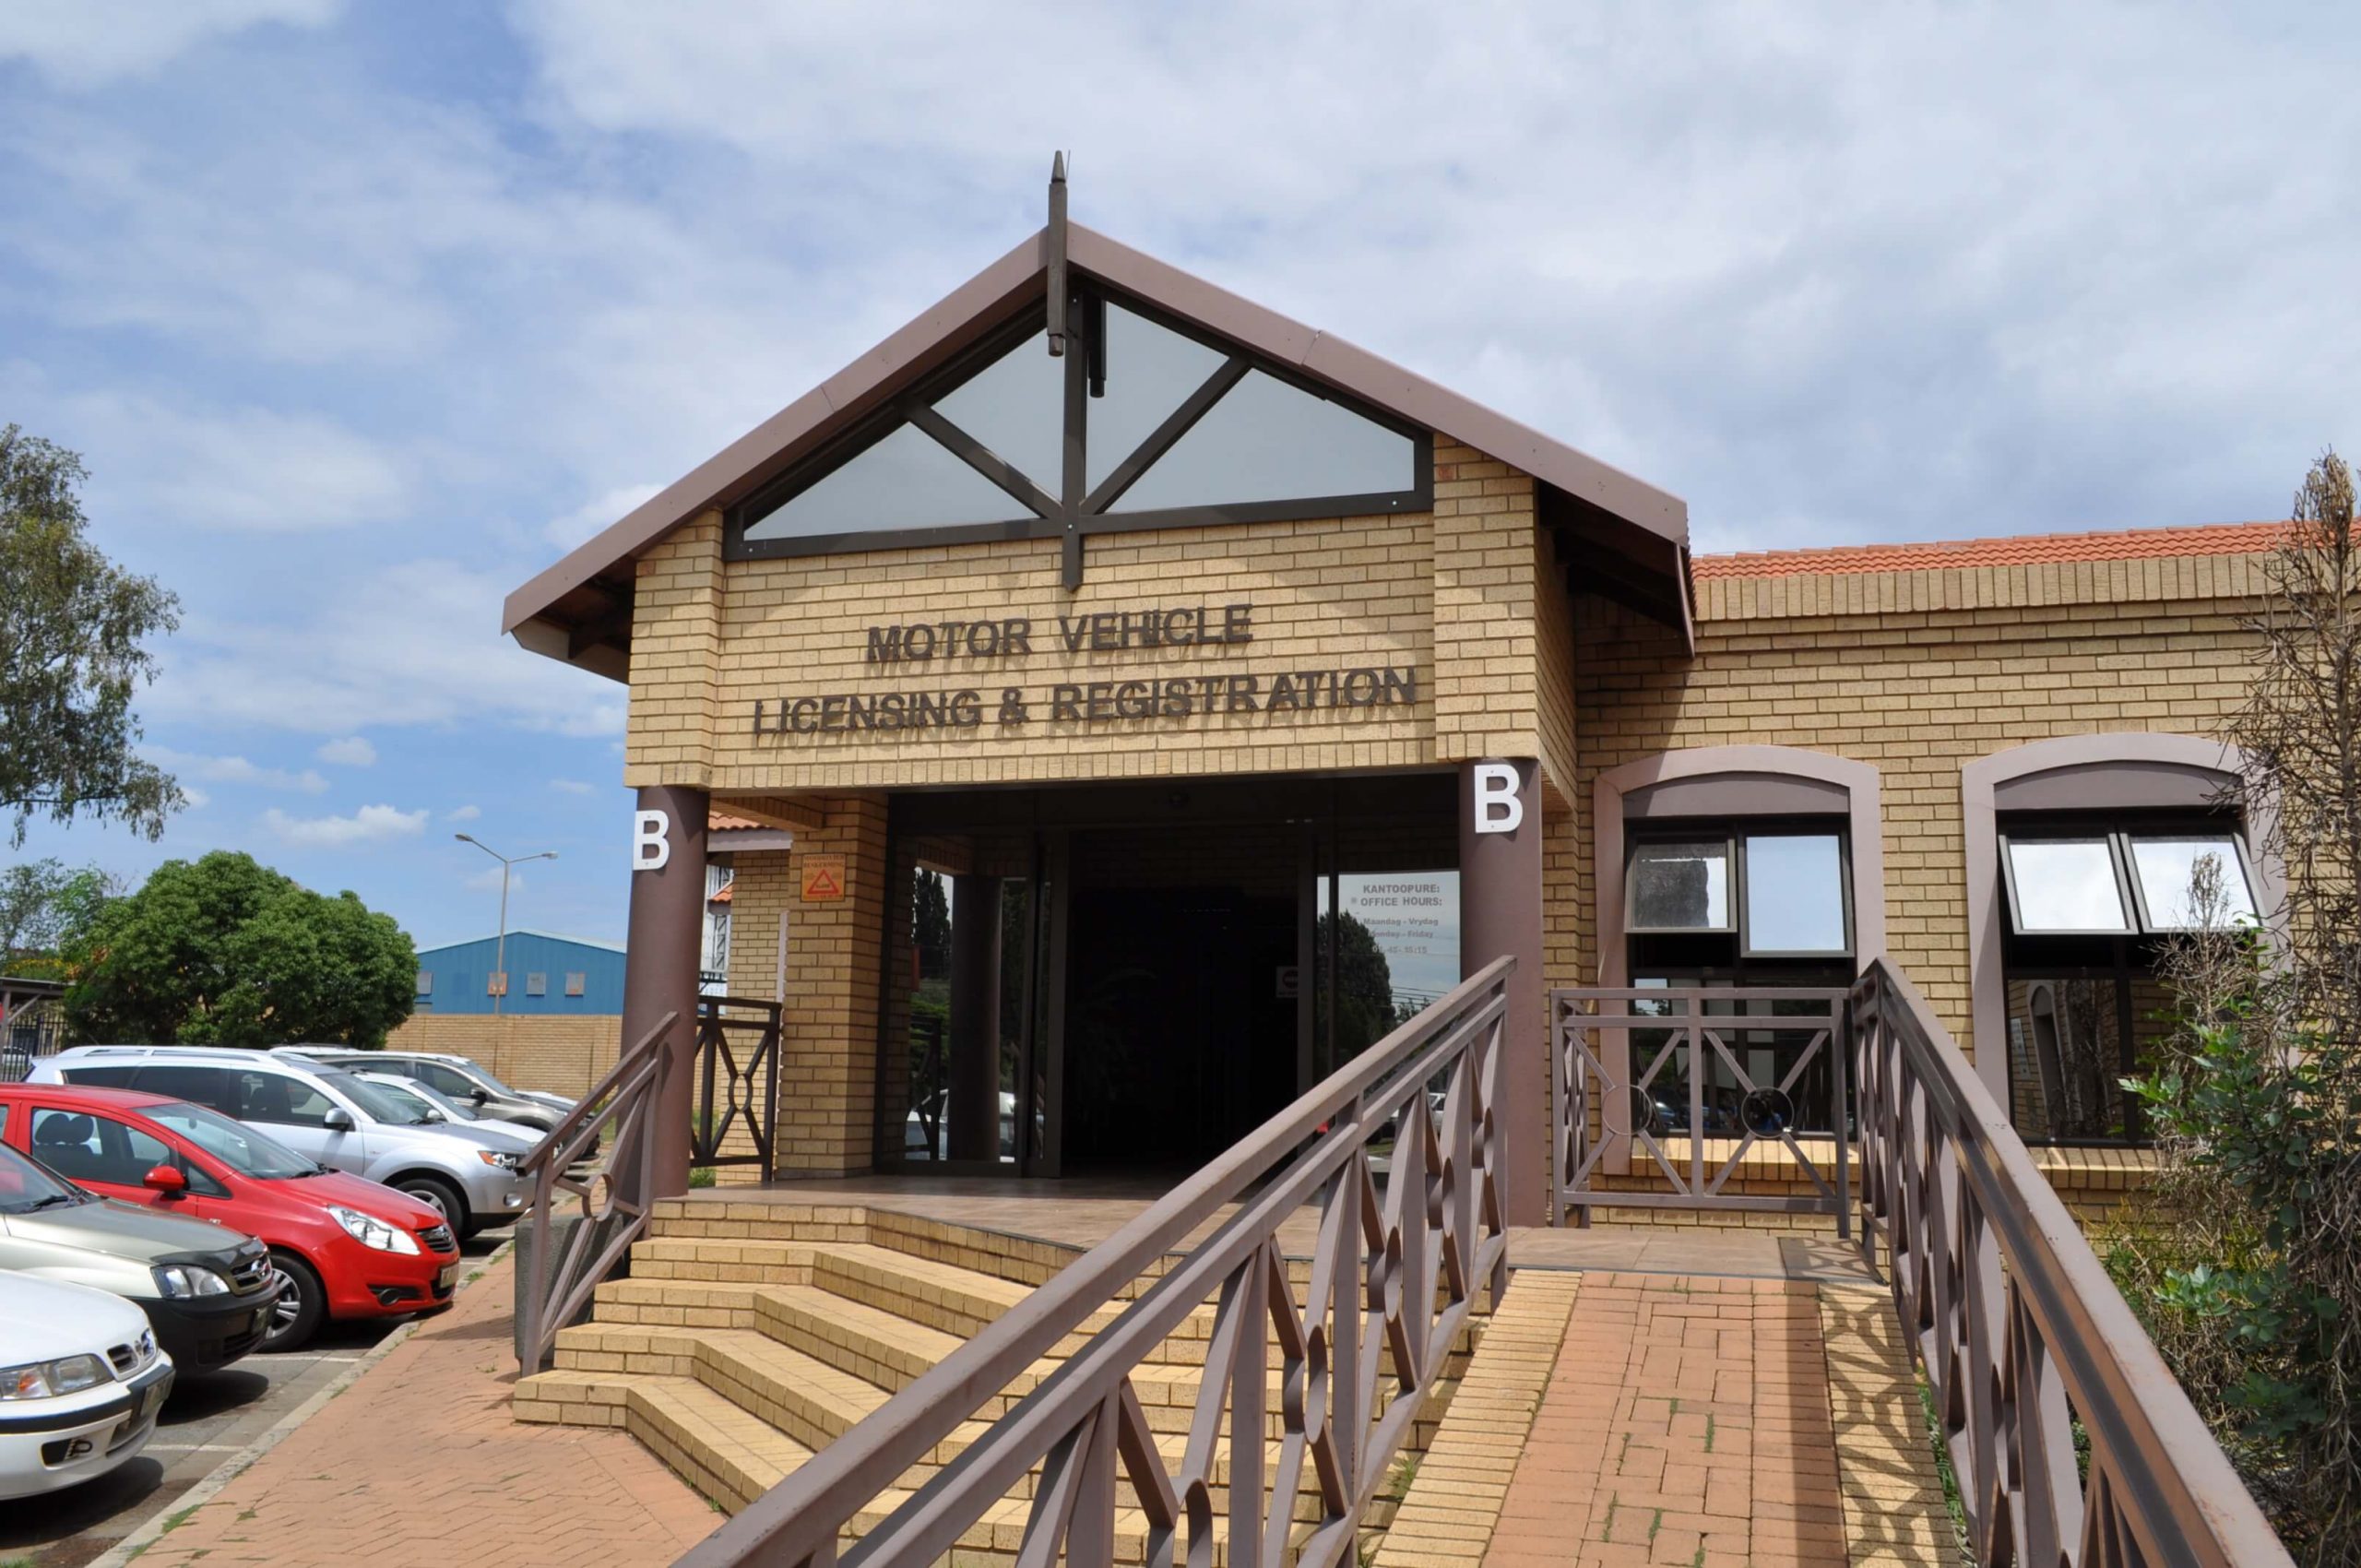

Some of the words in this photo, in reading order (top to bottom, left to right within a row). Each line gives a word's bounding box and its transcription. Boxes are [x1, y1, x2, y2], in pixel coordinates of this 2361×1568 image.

[867, 618, 1033, 663] MOTOR
[1058, 604, 1253, 652] VEHICLE
[753, 690, 981, 734] LICENSING
[998, 686, 1029, 726] &
[1052, 665, 1415, 720] REGISTRATION
[1475, 764, 1524, 834] B
[633, 809, 670, 871] B
[1360, 897, 1398, 907] OFFICE
[1403, 897, 1442, 907] HOURS:
[1364, 918, 1401, 927] Maandag
[1408, 918, 1439, 926] Vrydag
[1407, 930, 1434, 939] Friday
